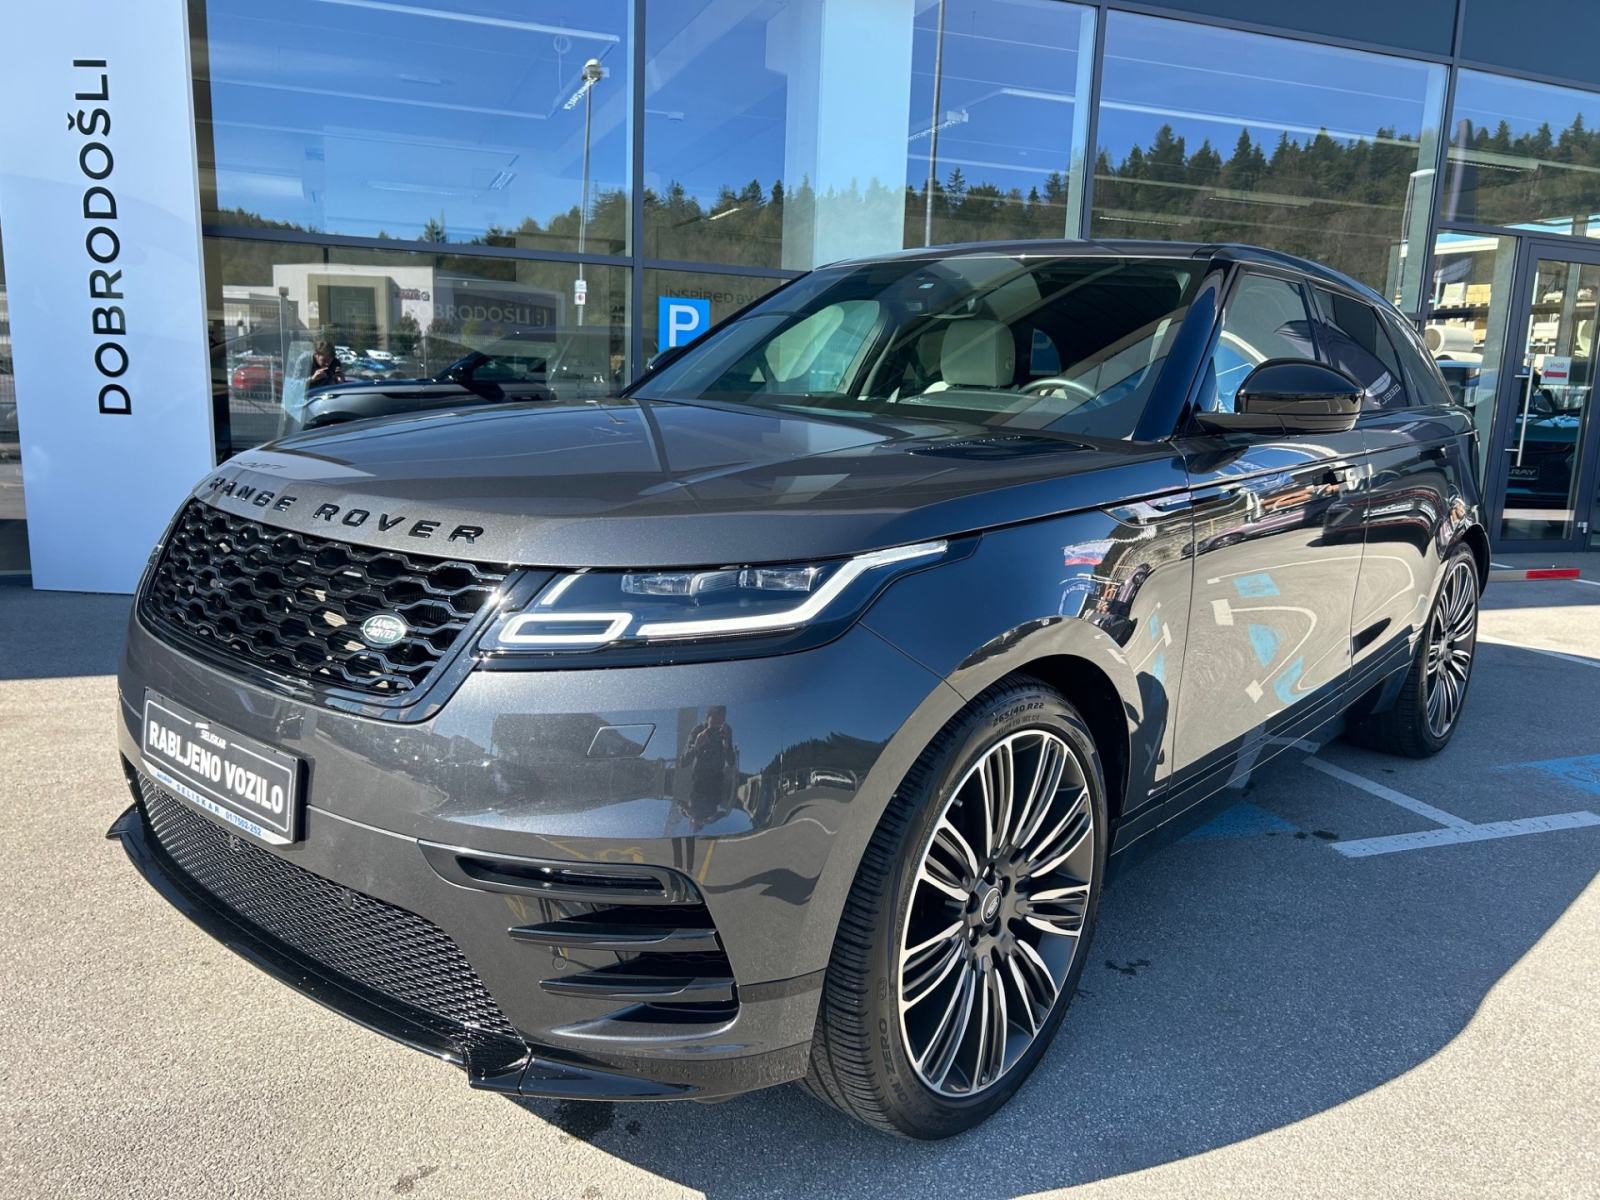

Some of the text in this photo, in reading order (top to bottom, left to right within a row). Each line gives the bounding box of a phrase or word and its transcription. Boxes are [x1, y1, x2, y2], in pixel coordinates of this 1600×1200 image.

[67, 59, 132, 415] DOBRODOŠLI
[669, 304, 700, 347] P
[209, 476, 485, 545] RANGE ROVER
[1027, 702, 1045, 711] R22
[149, 720, 284, 814] RABLJENO VOZILO
